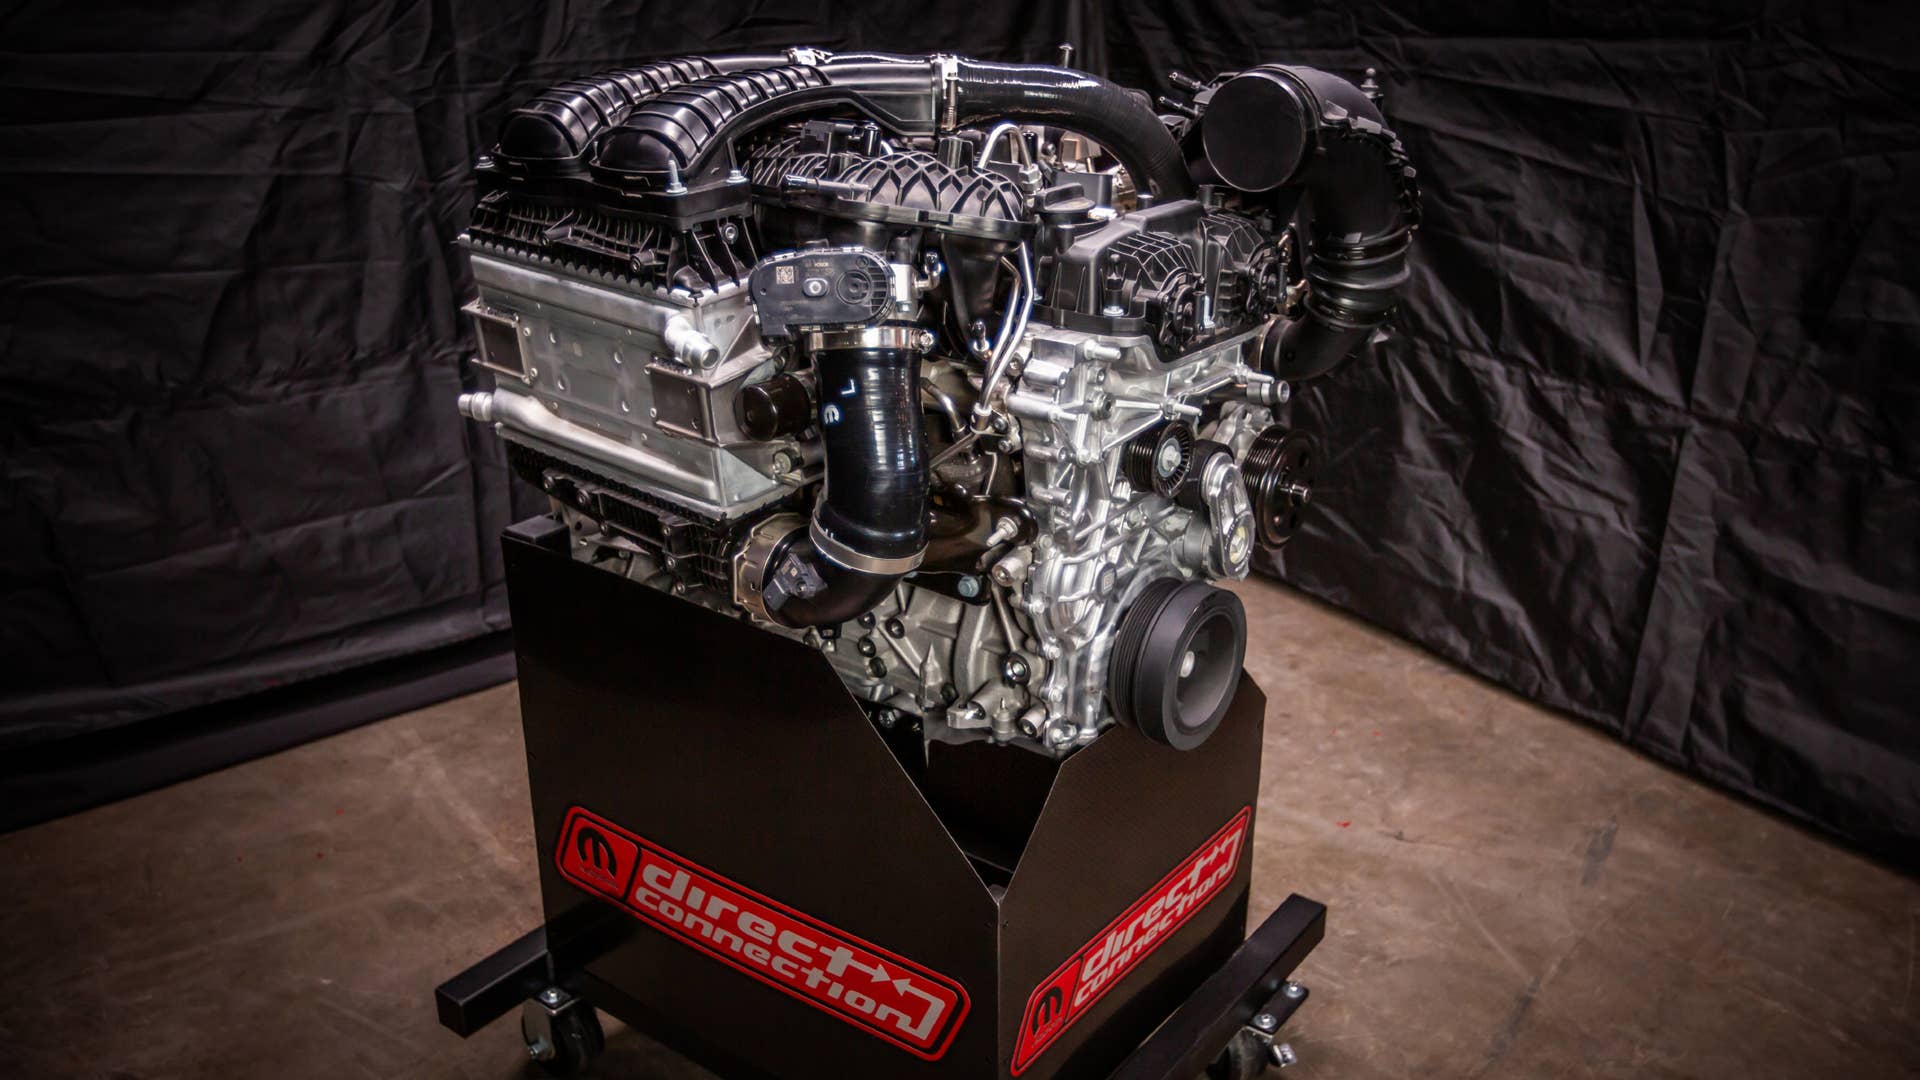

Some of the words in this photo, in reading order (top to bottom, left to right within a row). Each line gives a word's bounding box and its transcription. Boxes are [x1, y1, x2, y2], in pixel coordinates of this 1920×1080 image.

[636, 886, 934, 1039] connection
[643, 864, 856, 977] direct
[1074, 860, 1234, 1008] connection
[1082, 854, 1214, 982] direct
